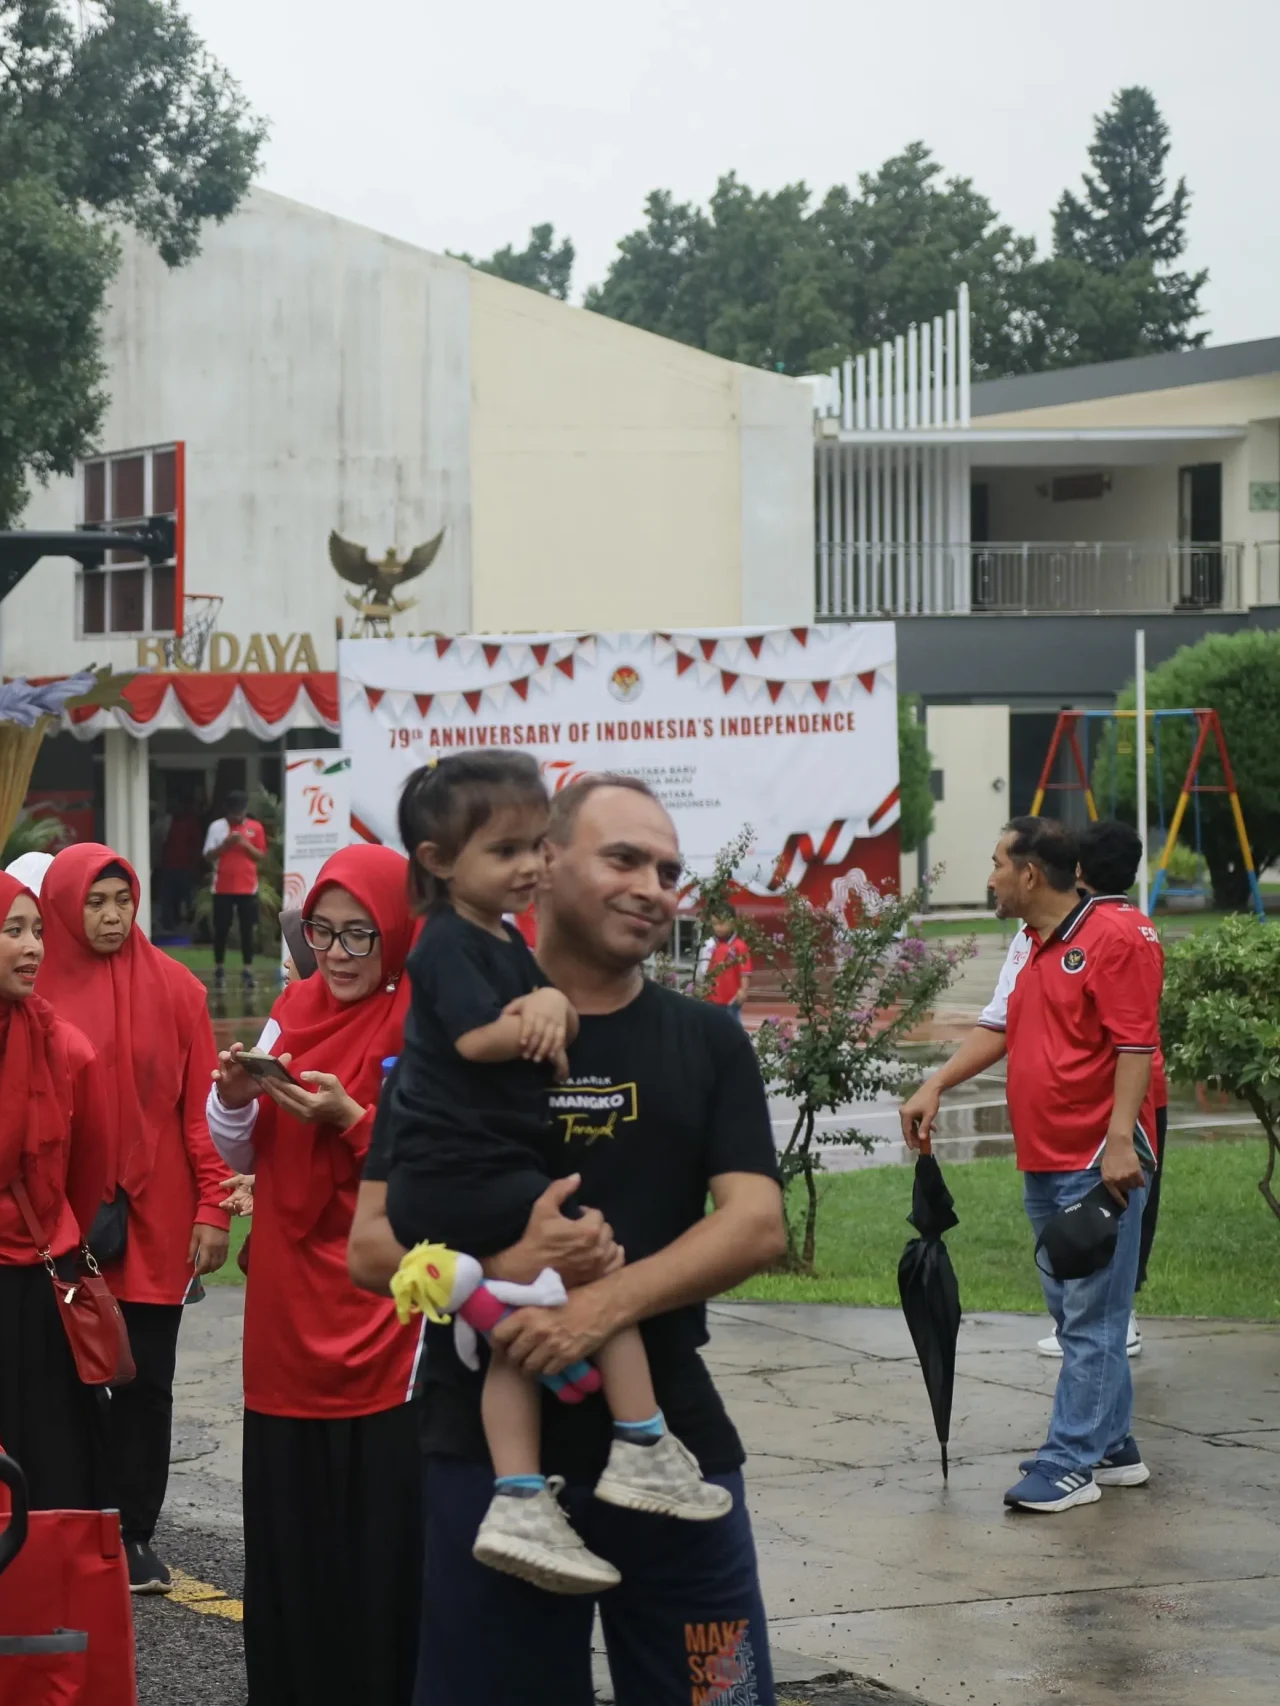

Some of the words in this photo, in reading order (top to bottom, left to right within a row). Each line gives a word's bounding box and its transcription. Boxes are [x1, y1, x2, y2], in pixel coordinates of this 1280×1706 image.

[429, 723, 561, 748] ANNIVERSARY
[568, 722, 590, 743] OF
[596, 718, 715, 741] INDONESIA'S
[720, 711, 857, 737] INDEPENDENCE
[548, 1094, 625, 1110] MANGKO
